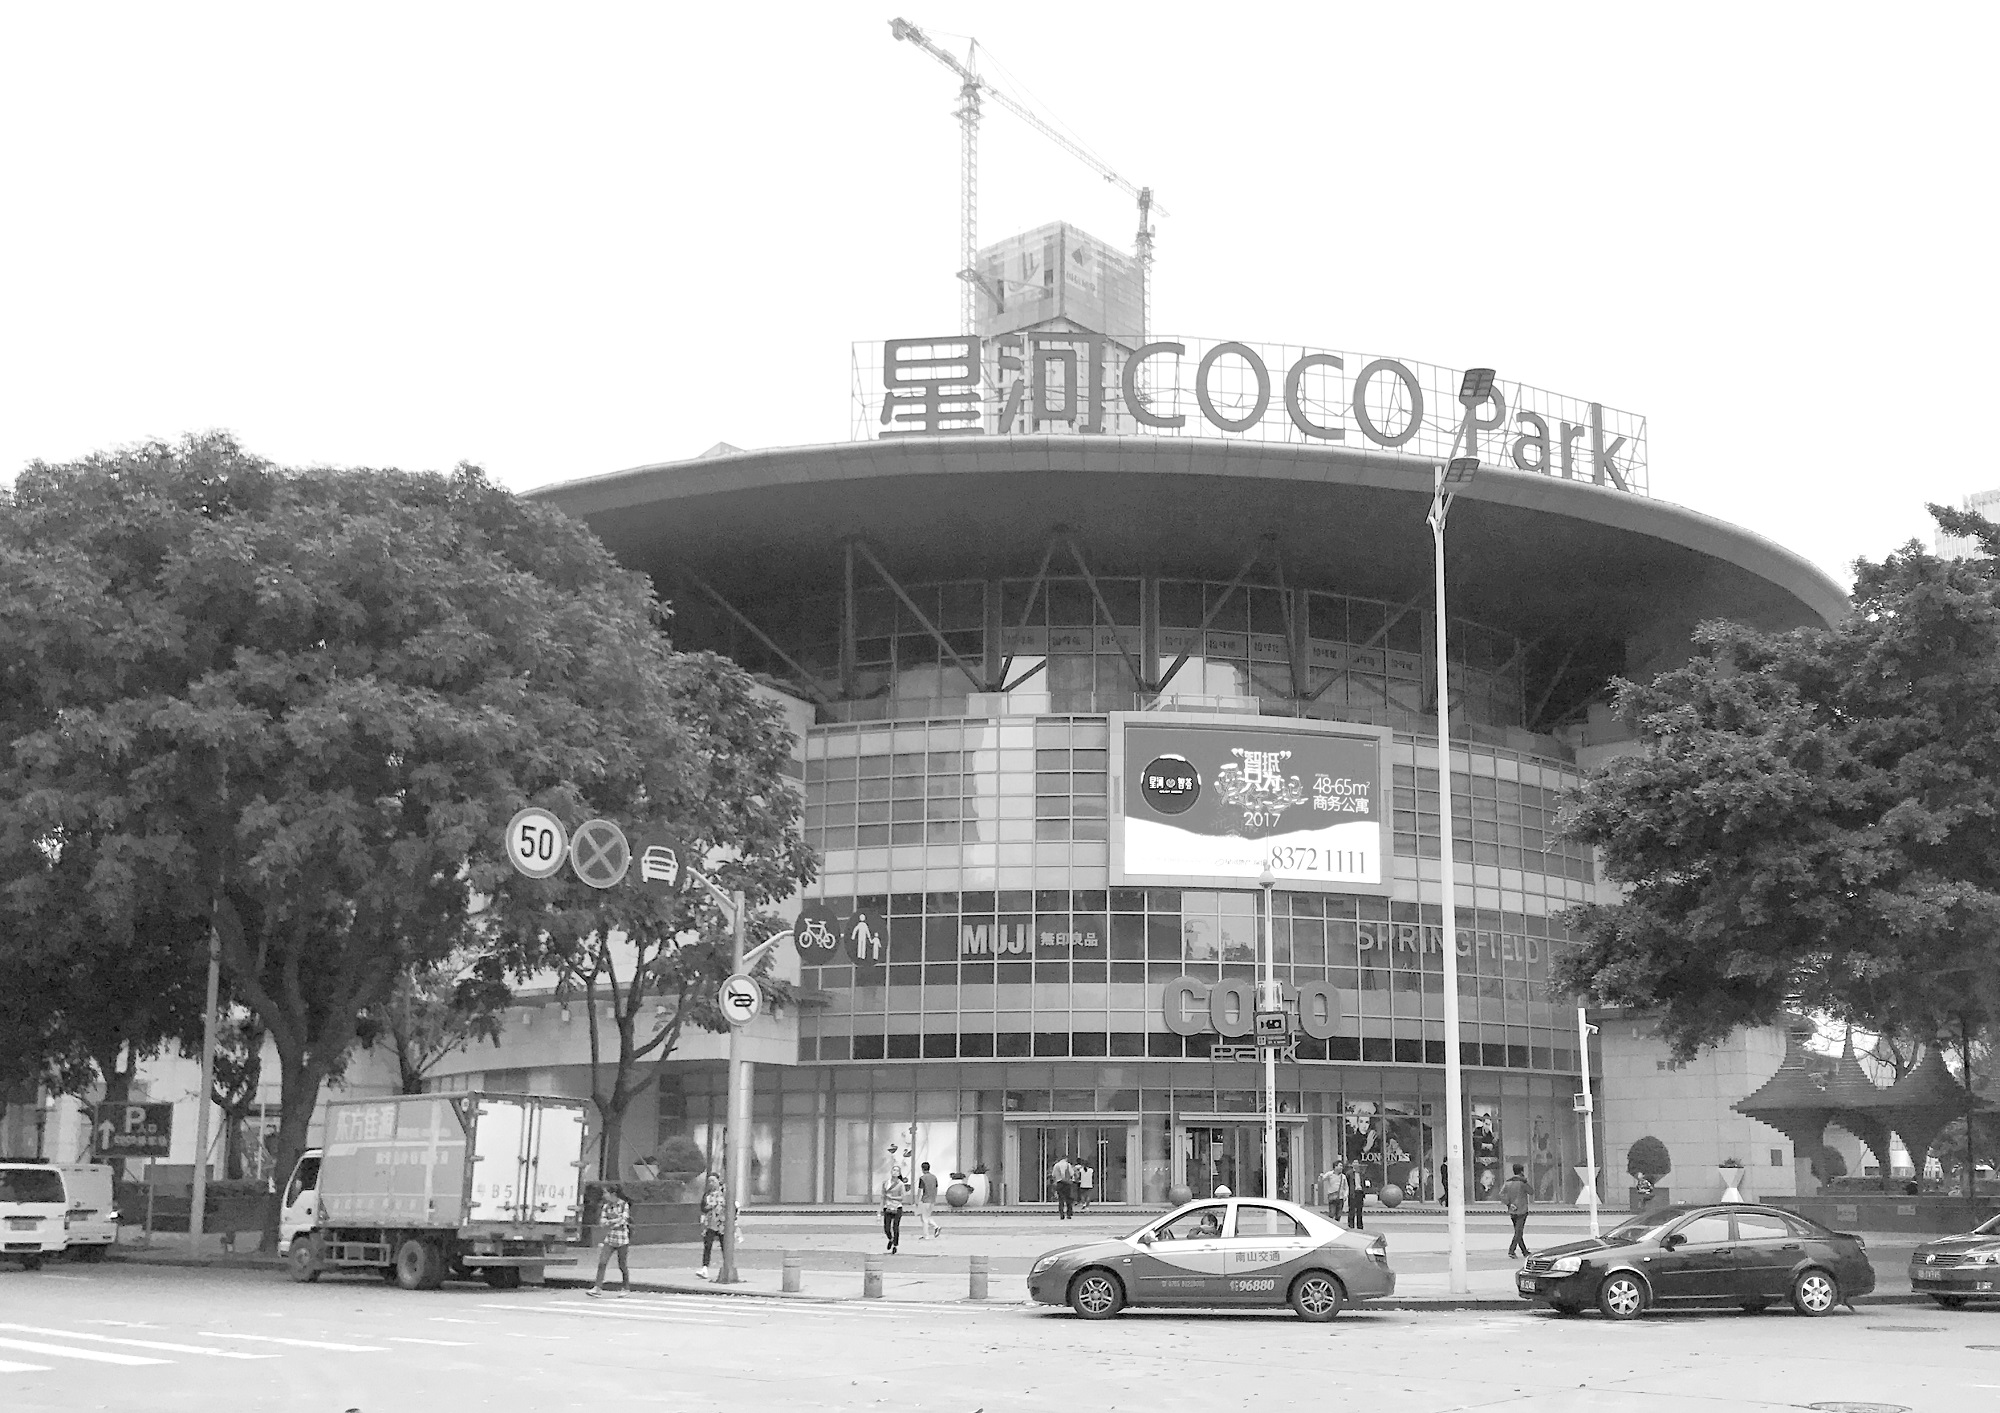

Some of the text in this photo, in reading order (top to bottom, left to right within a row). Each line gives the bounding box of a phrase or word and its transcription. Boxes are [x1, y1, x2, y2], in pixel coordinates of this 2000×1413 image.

[879, 333, 1630, 491] 星河 COCO Park
[1243, 811, 1281, 827] 2017
[1313, 795, 1370, 814] 商务公寓
[520, 825, 554, 861] 50
[1271, 845, 1365, 874] 8372 1111
[962, 923, 1098, 955] MUJI 無印良品
[1353, 922, 1539, 964] SPRINGFIELD
[125, 1106, 147, 1133] P
[1235, 1251, 1281, 1263] 南山交通
